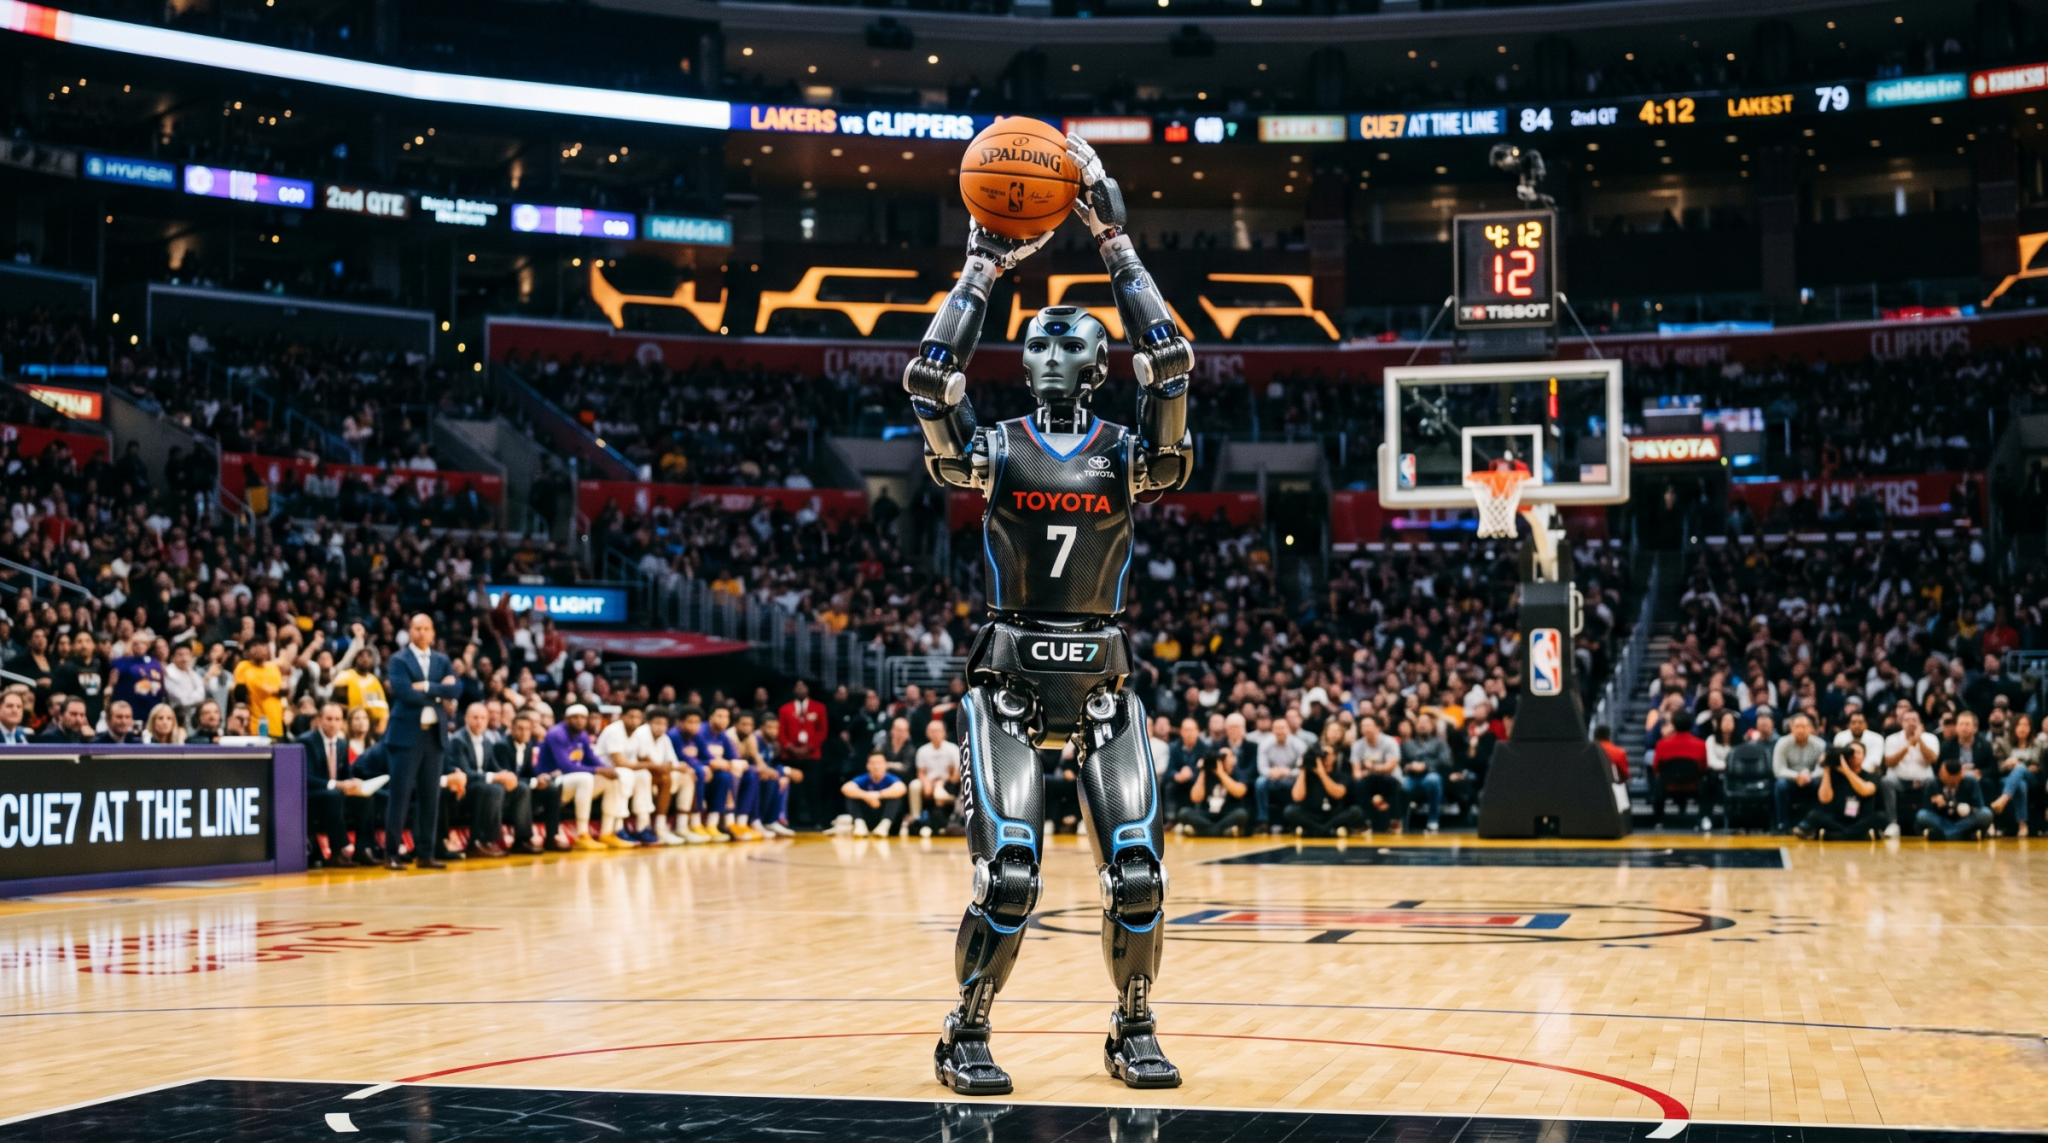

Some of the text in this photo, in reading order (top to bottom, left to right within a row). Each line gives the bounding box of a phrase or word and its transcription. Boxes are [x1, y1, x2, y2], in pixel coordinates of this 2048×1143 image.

[1638, 97, 1696, 125] 4:12
[1727, 94, 1794, 117] LAKEST
[1815, 86, 1850, 112] 79
[750, 106, 975, 140] LAKERS vs CLIPPERS
[1360, 114, 1407, 140] CUE7
[1407, 113, 1431, 137] AT
[1429, 112, 1463, 136] THE
[1462, 110, 1500, 135] LINE
[1520, 107, 1554, 133] 84
[1570, 109, 1598, 126] 2nd
[979, 147, 1063, 175] SPALDING
[326, 185, 364, 212] 2nd
[366, 191, 406, 217] QTE
[1484, 221, 1542, 249] 4:12
[1494, 249, 1536, 297] 12
[1485, 303, 1550, 320] TISSOT
[1084, 470, 1116, 479] TOYOTA
[1012, 491, 1112, 514] TOYOTA
[1046, 524, 1078, 579] 7
[549, 596, 605, 615] LIGHT
[1031, 641, 1099, 662] CUE7
[959, 731, 975, 825] TOYOTA
[0, 786, 260, 848] CUE7 AT THE LINE
